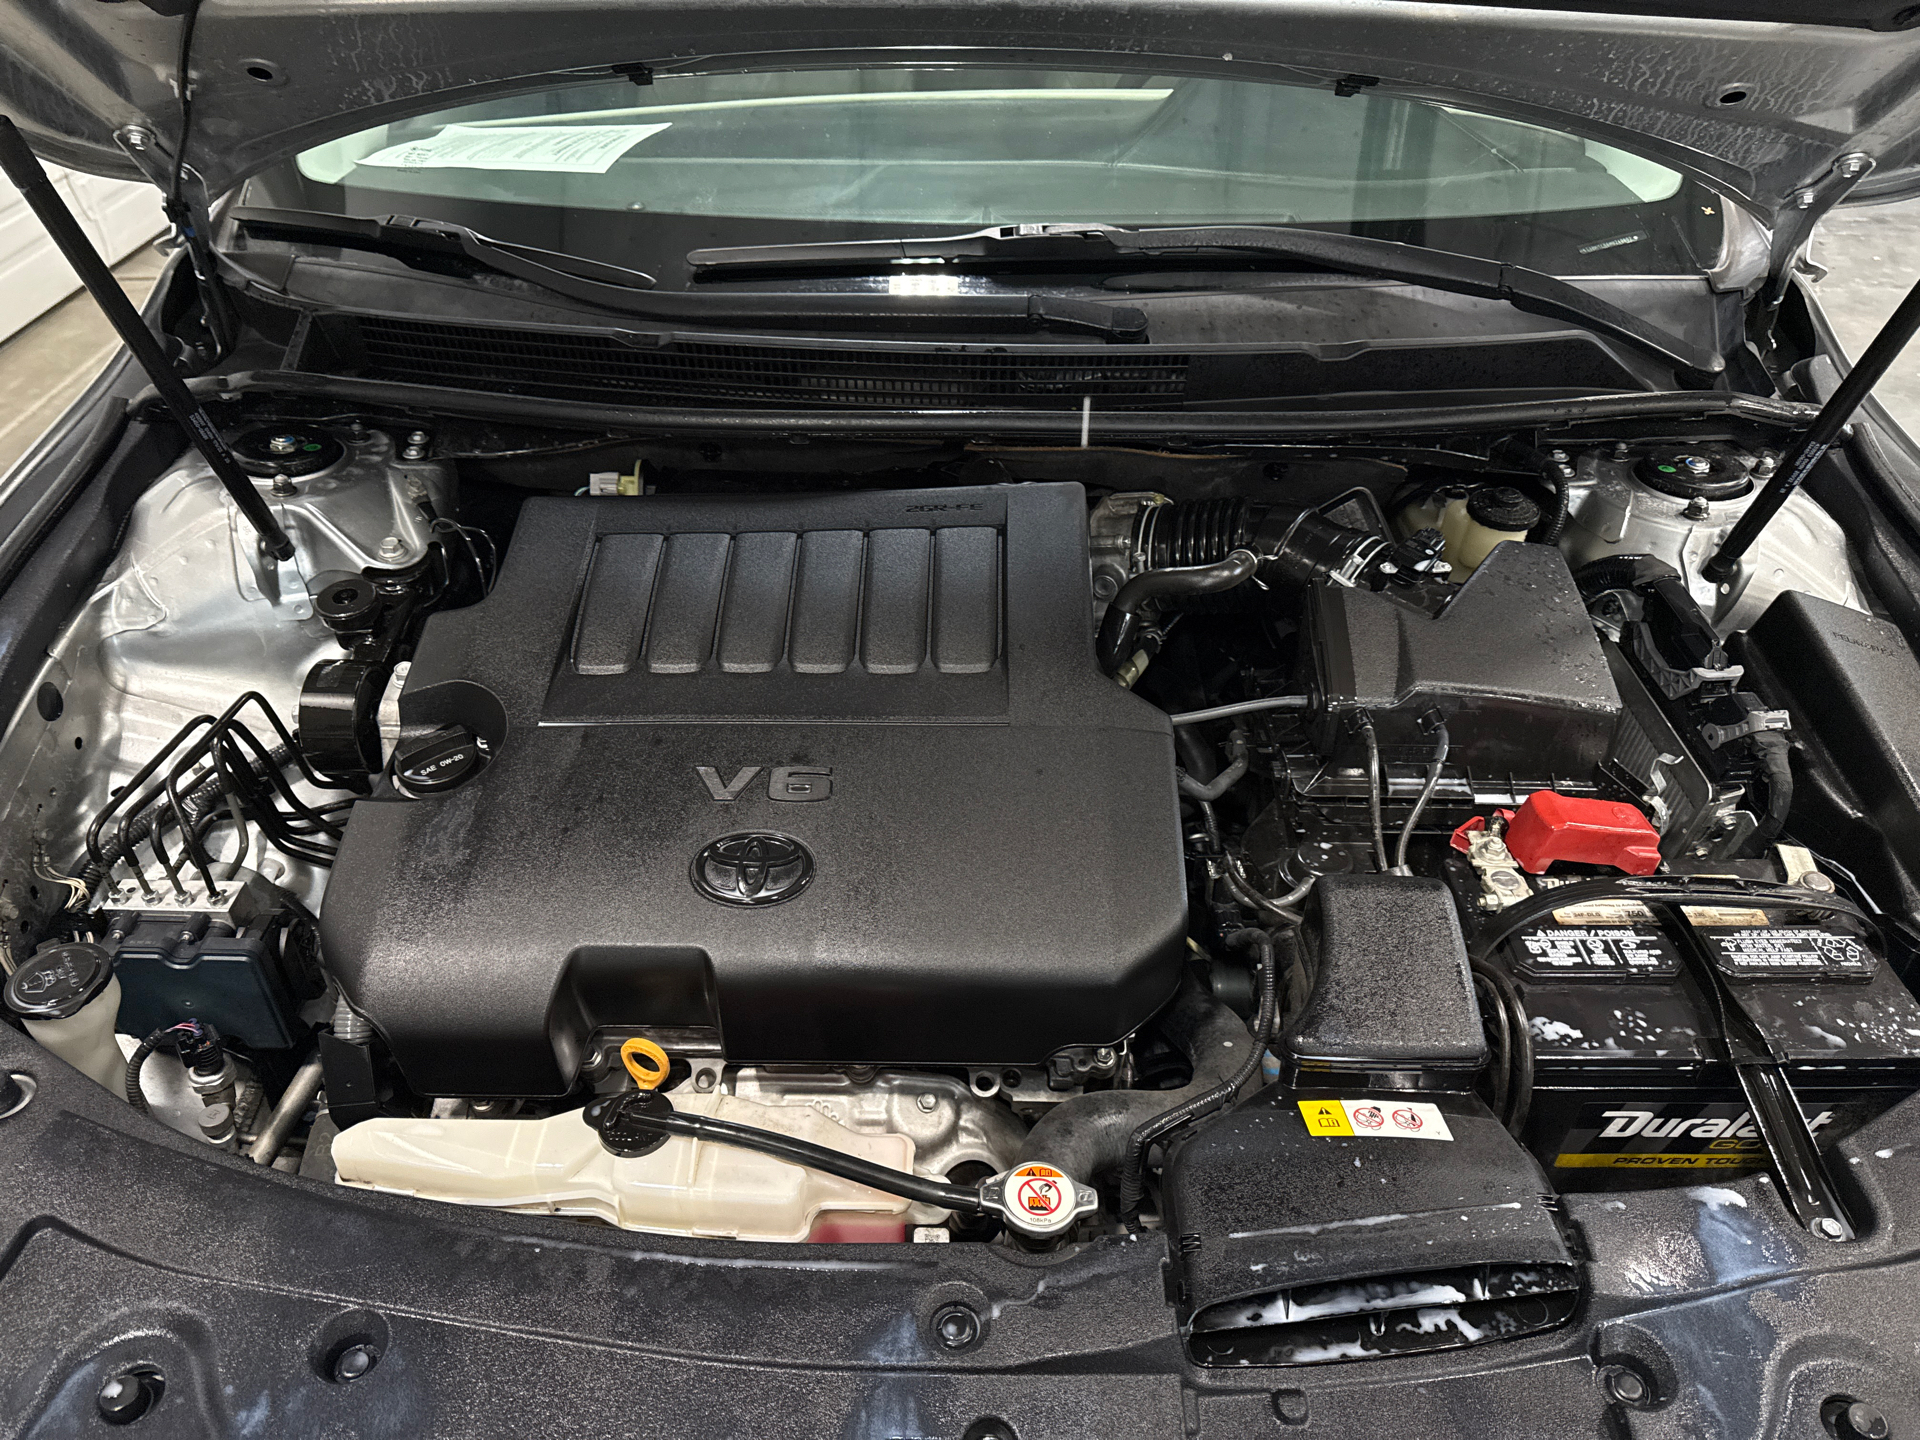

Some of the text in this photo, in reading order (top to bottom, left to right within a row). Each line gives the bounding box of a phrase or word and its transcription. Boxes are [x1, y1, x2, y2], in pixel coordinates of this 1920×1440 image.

[905, 503, 984, 513] 2GR-FE
[420, 753, 465, 776] SAE 0W-20
[695, 765, 834, 802] V6
[1546, 929, 1589, 937] DANGER
[1597, 929, 1636, 937] POISON
[1599, 1111, 1836, 1138] Duralat
[1612, 1157, 1699, 1165] PROVEN
